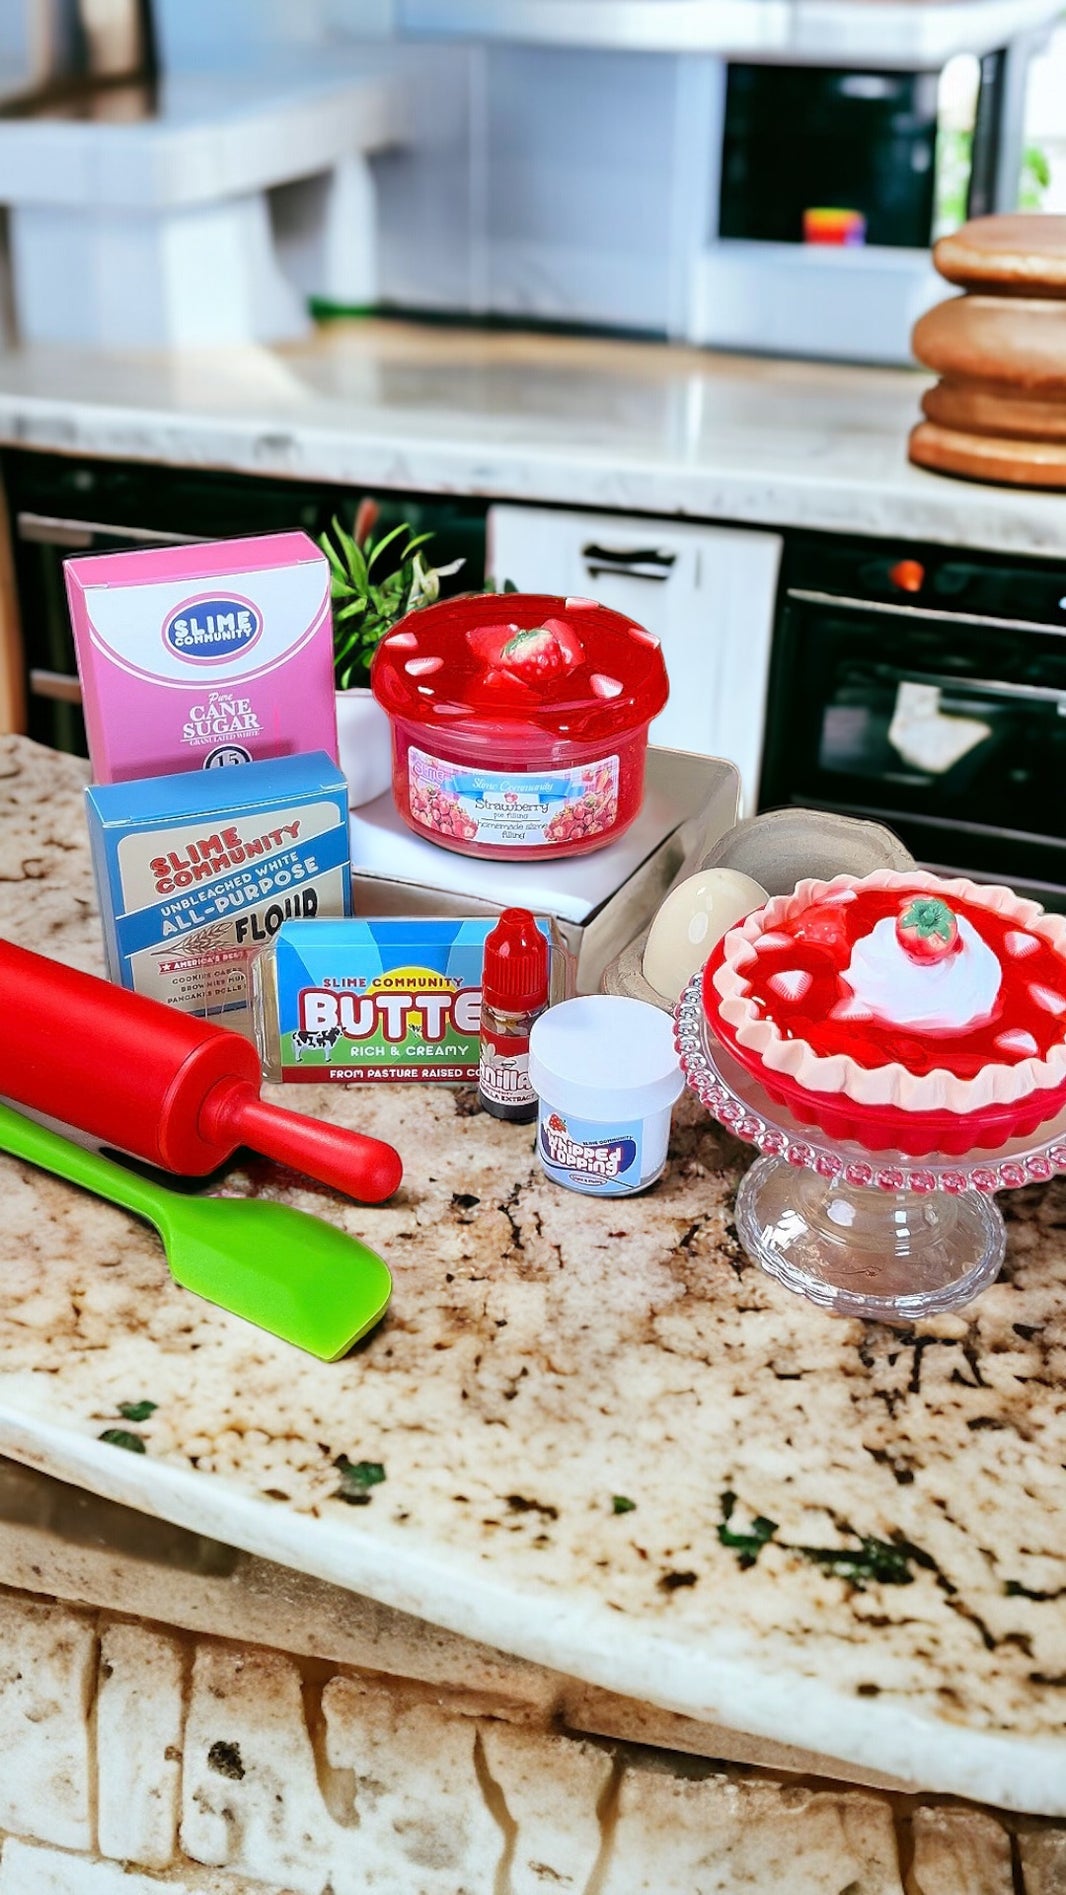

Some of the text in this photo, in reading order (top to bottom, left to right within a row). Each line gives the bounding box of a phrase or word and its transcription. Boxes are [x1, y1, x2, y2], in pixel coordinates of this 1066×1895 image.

[174, 610, 252, 638] SLIME
[175, 627, 253, 646] COMMUNITY
[208, 692, 233, 704] Pure
[189, 699, 252, 722] CANE
[183, 713, 261, 738] SUGAR
[472, 778, 554, 793] Slime Community
[475, 797, 550, 814] Strawberry
[150, 826, 243, 878] SLIME
[155, 820, 301, 894] COMMUNITY
[161, 851, 299, 917] UNBLEACHED WHITE
[162, 856, 319, 937] ALL-PURPOSE
[174, 955, 220, 970] AMERICA'S
[323, 977, 464, 988] SLIME COMMUNITY
[301, 990, 480, 1041] BUTTE
[350, 1045, 469, 1057] RICH & CREAMY
[330, 1069, 364, 1079] FROM
[367, 1068, 418, 1078] PASTURE
[422, 1068, 462, 1078] RAISED
